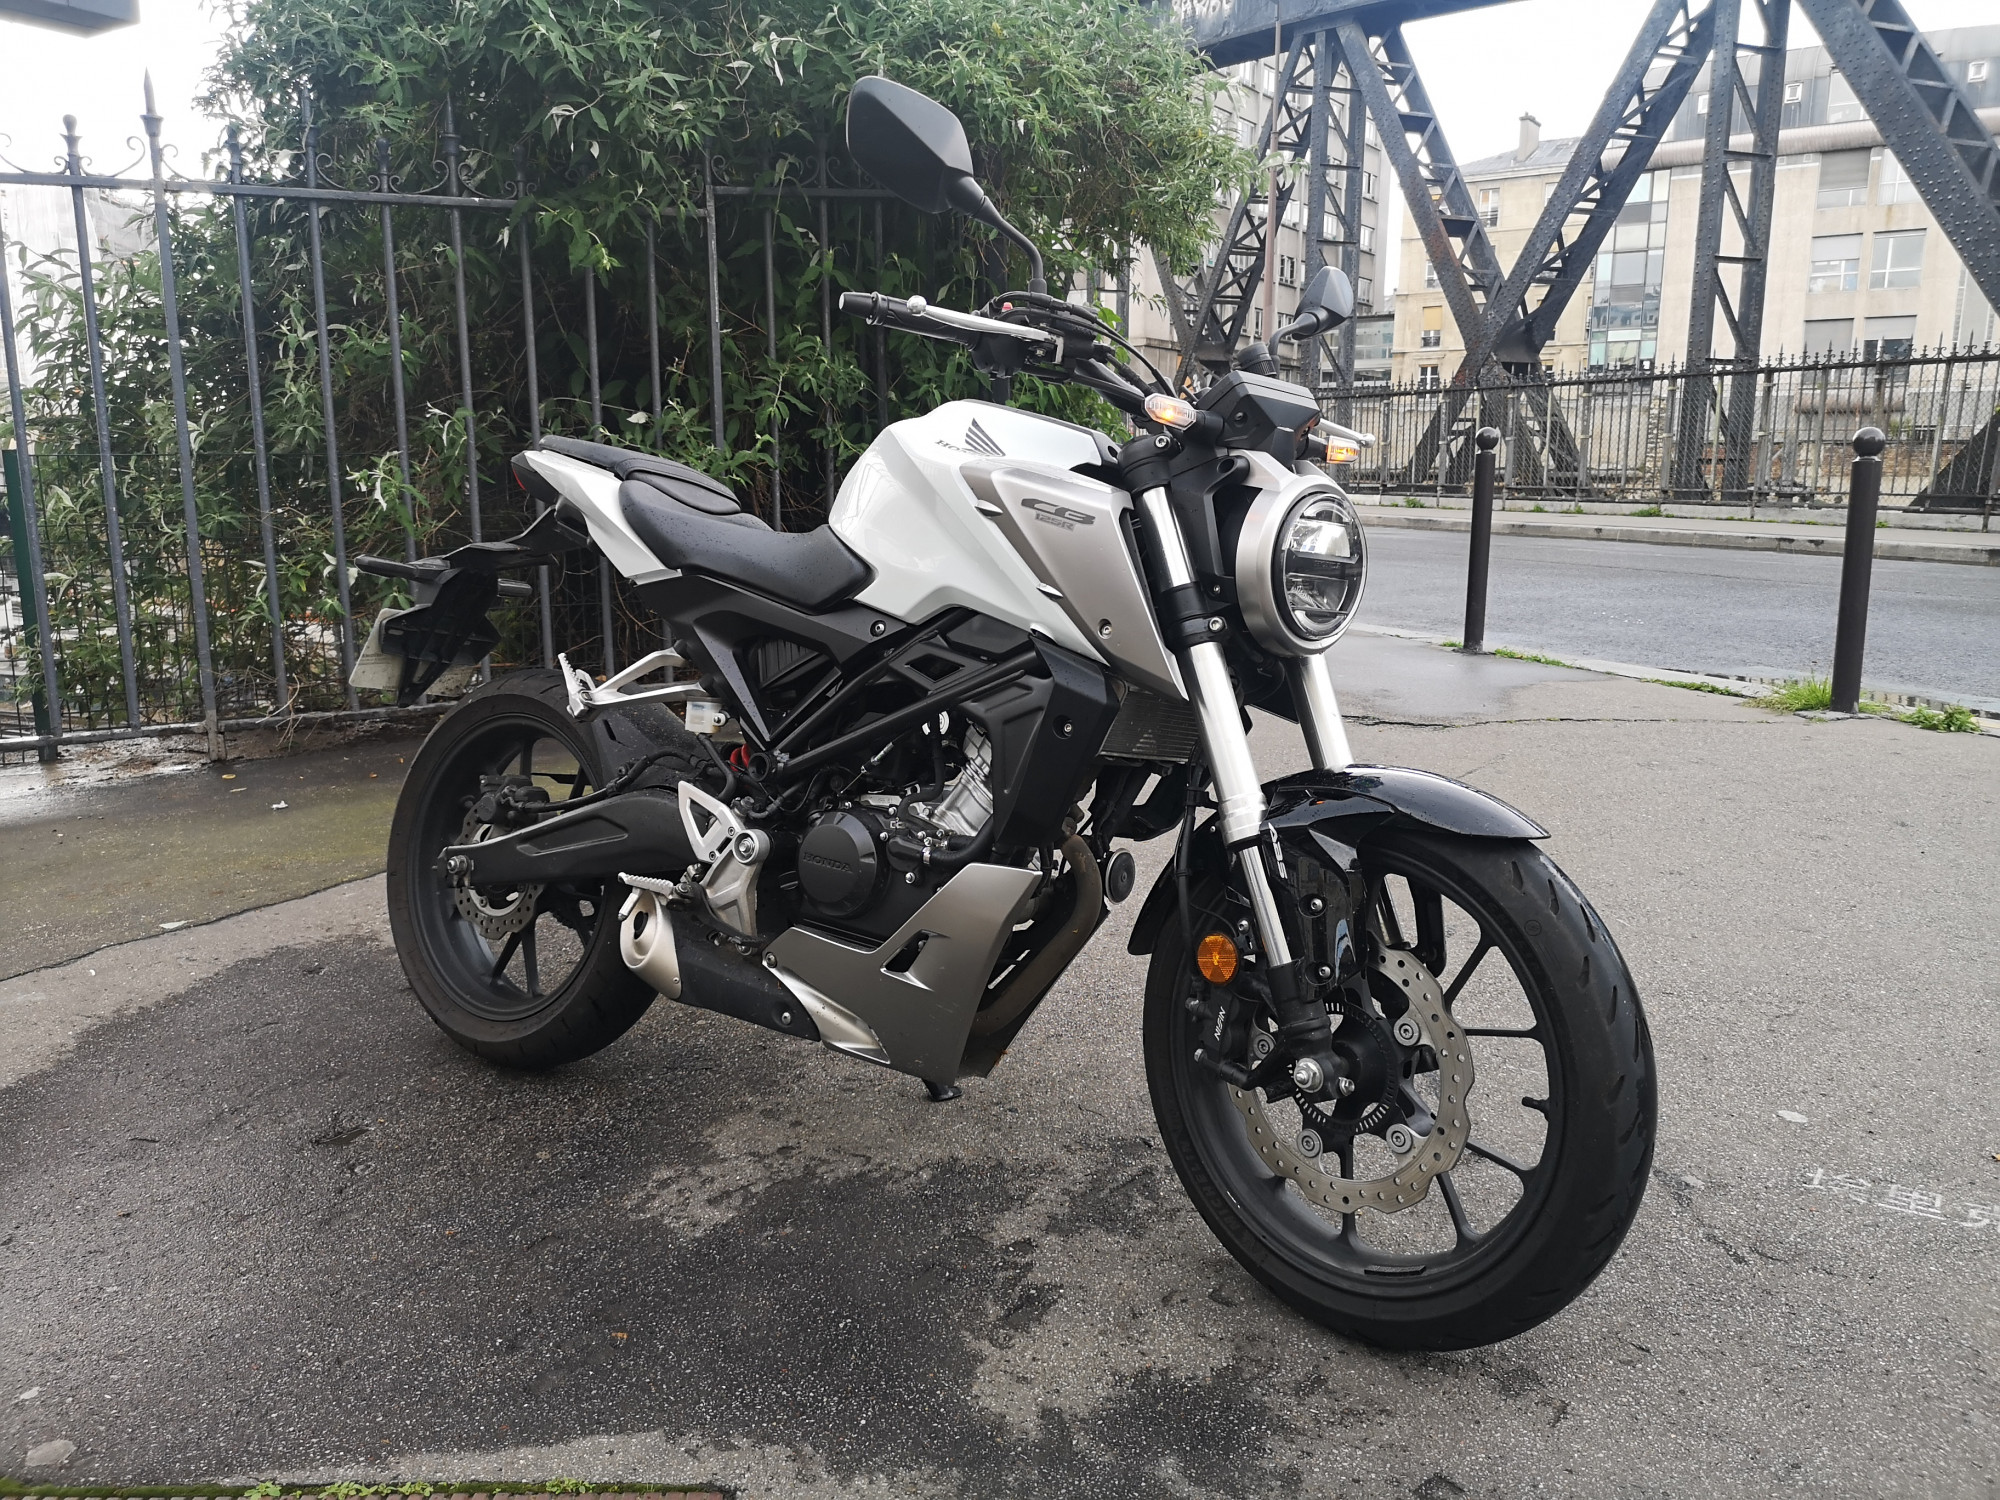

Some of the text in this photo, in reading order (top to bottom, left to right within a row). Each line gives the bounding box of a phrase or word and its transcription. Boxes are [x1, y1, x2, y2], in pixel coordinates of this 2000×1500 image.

[1021, 498, 1096, 525] CB
[1034, 512, 1076, 533] 125R
[802, 851, 853, 874] HONDA
[1268, 822, 1288, 879] ABS
[1179, 1139, 1241, 1231] MICHELIN
